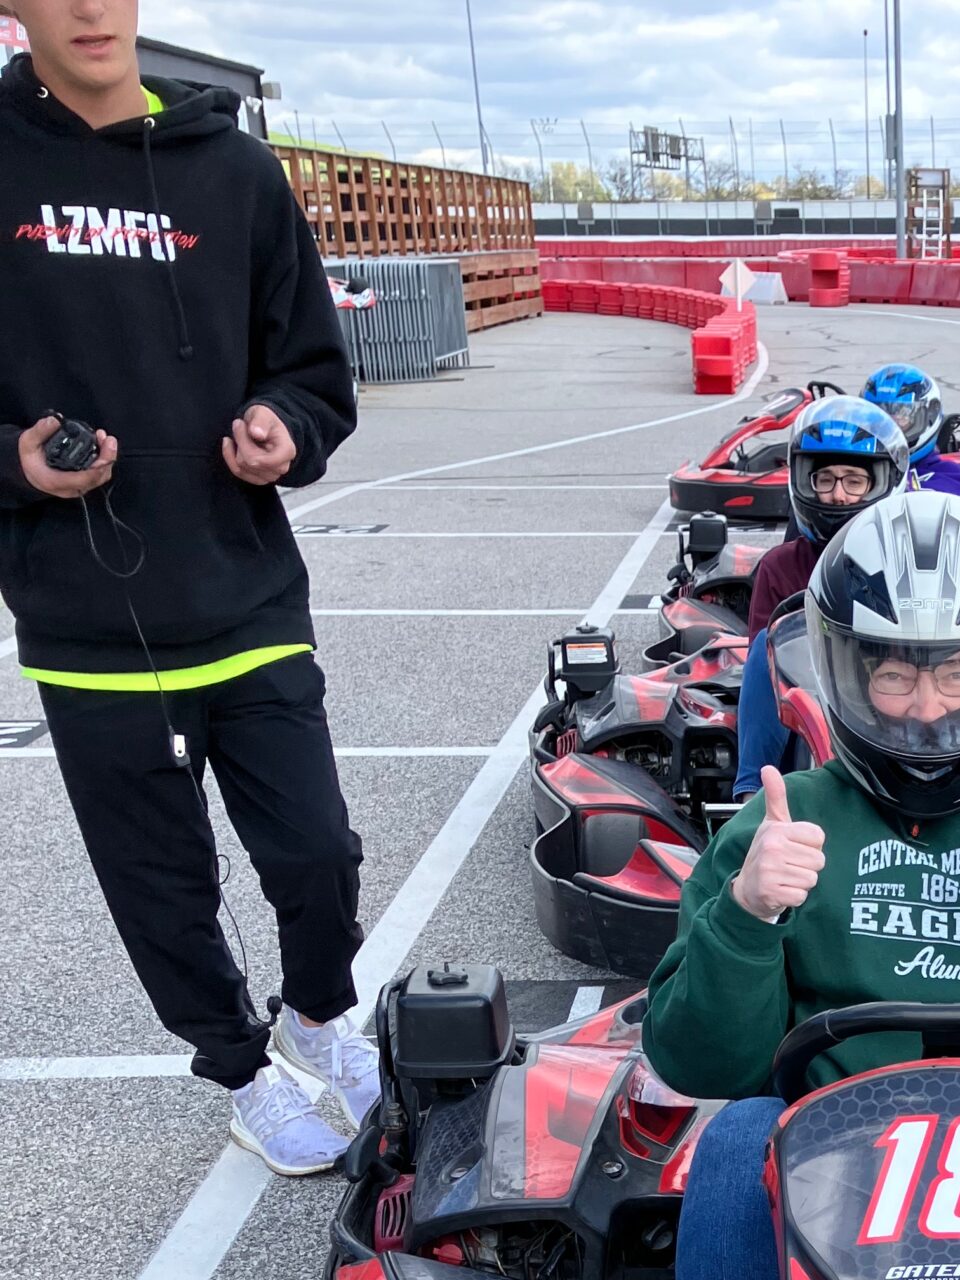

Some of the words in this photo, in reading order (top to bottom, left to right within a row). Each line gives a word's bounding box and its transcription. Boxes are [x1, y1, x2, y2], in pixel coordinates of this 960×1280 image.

[899, 599, 954, 613] zamp
[858, 839, 938, 876] CENTRAL
[854, 883, 905, 897] FAYETTE
